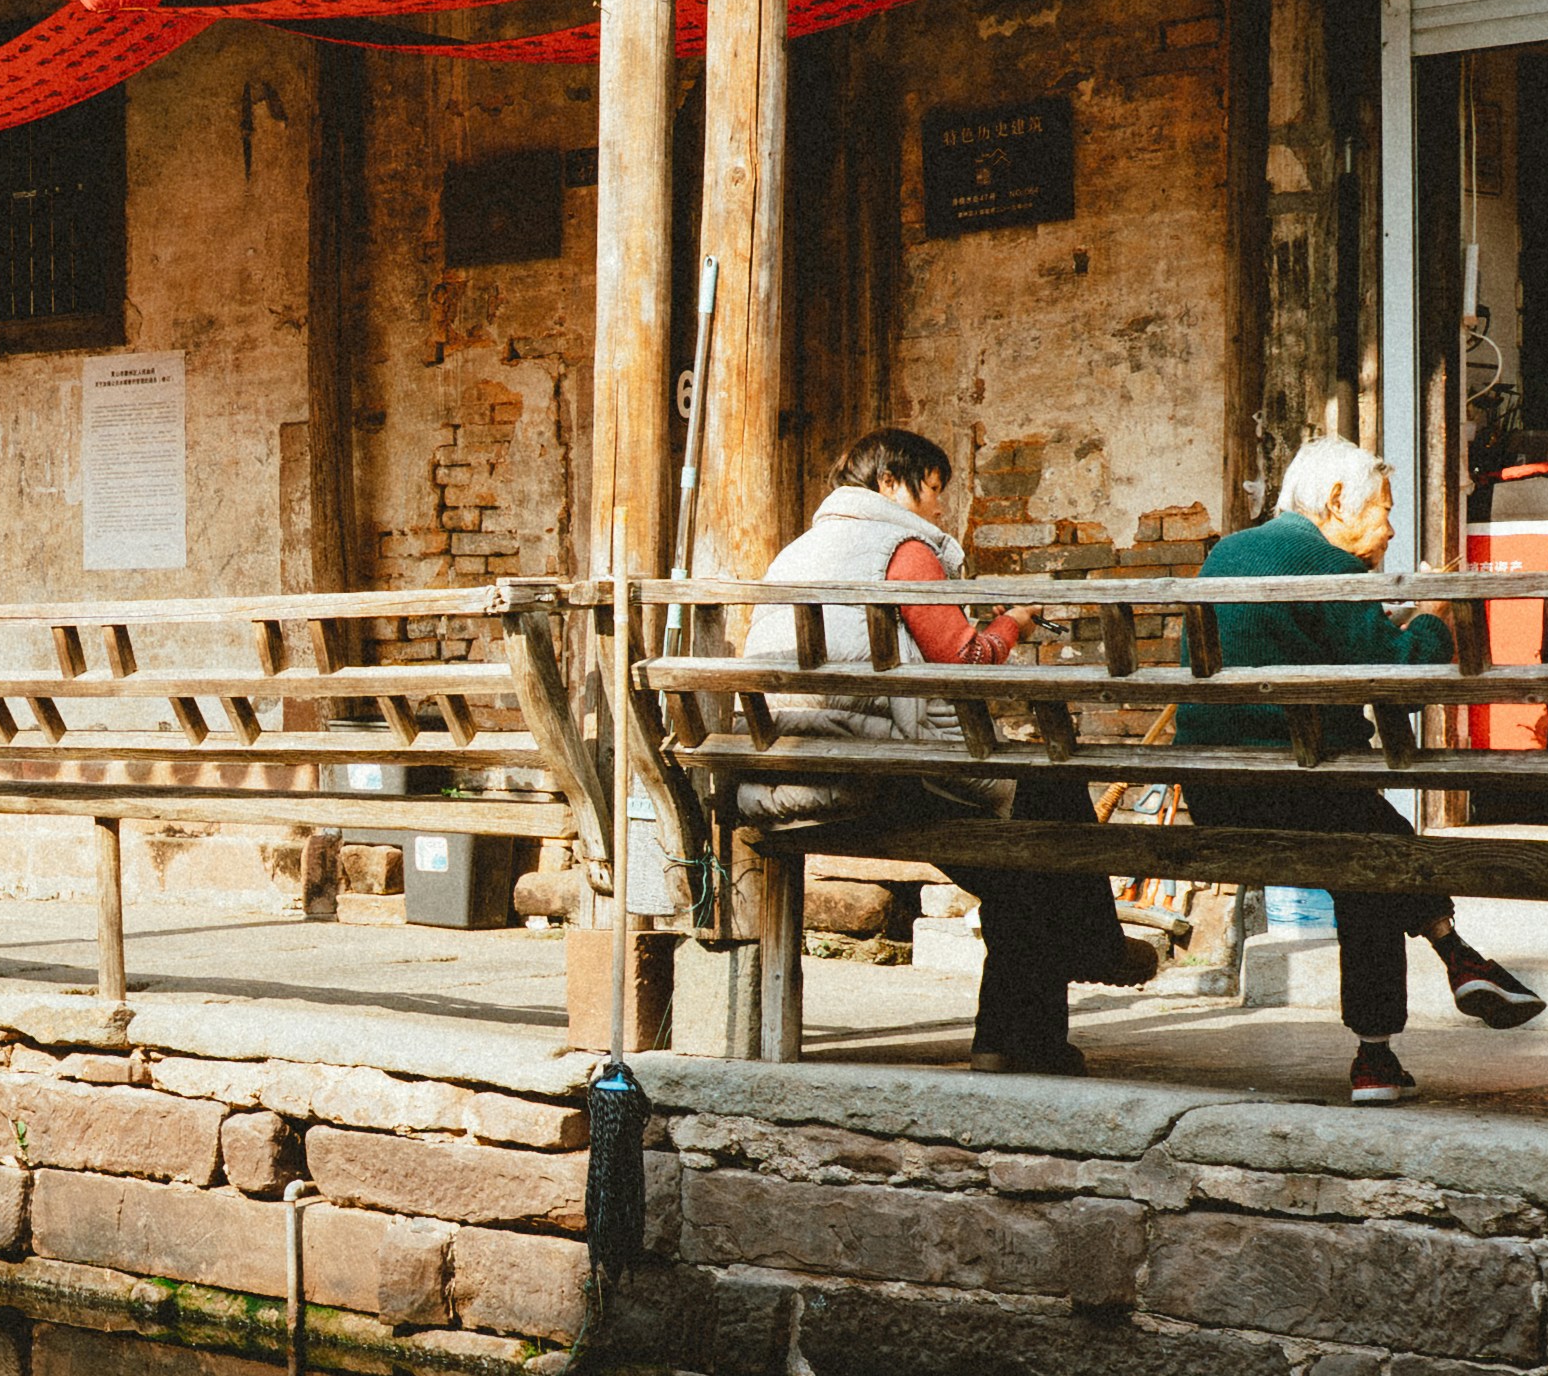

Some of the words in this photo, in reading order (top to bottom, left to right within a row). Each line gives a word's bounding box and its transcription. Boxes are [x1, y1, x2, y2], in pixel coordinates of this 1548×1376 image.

[942, 115, 1044, 146] 特色历史建筑
